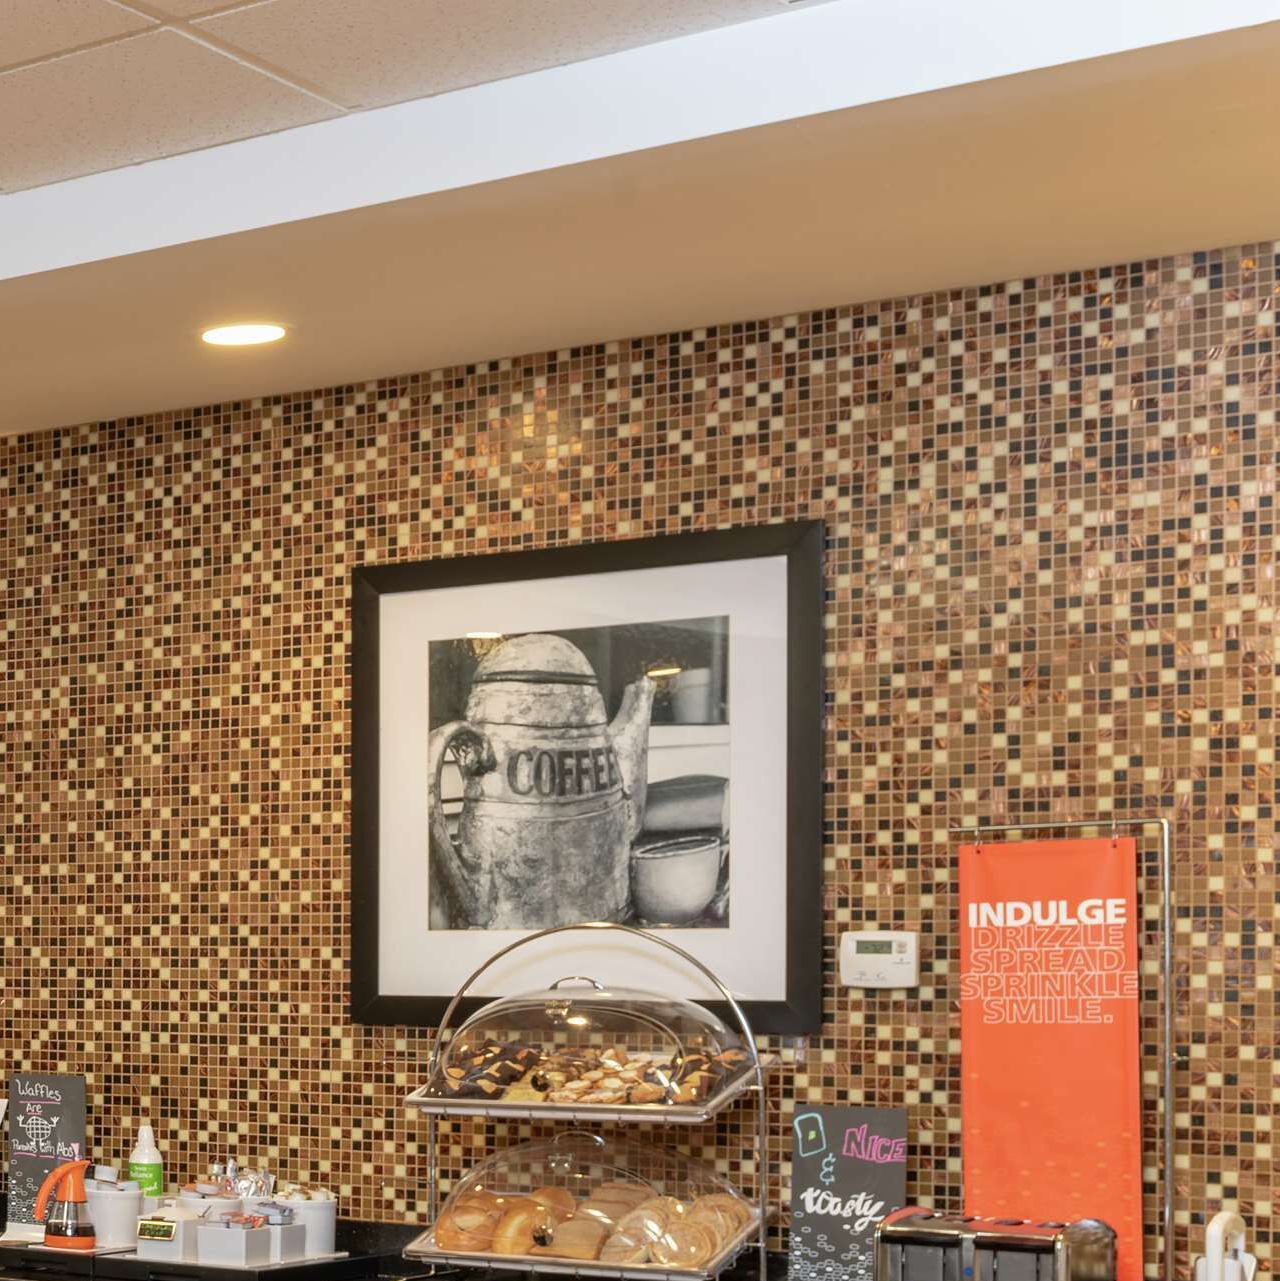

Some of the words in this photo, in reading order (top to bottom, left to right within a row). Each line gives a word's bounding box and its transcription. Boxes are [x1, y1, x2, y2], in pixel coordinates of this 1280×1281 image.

[507, 747, 619, 797] COFFEE
[968, 898, 1127, 928] INDULGE
[971, 923, 1125, 951] DRIZZLE
[971, 948, 1125, 974] SPREAD
[960, 971, 1139, 1001] SPRINKLE
[983, 997, 1114, 1024] SMILE.
[15, 1079, 62, 1102] Waffles
[26, 1103, 43, 1113] Are
[842, 1123, 907, 1163] NICE
